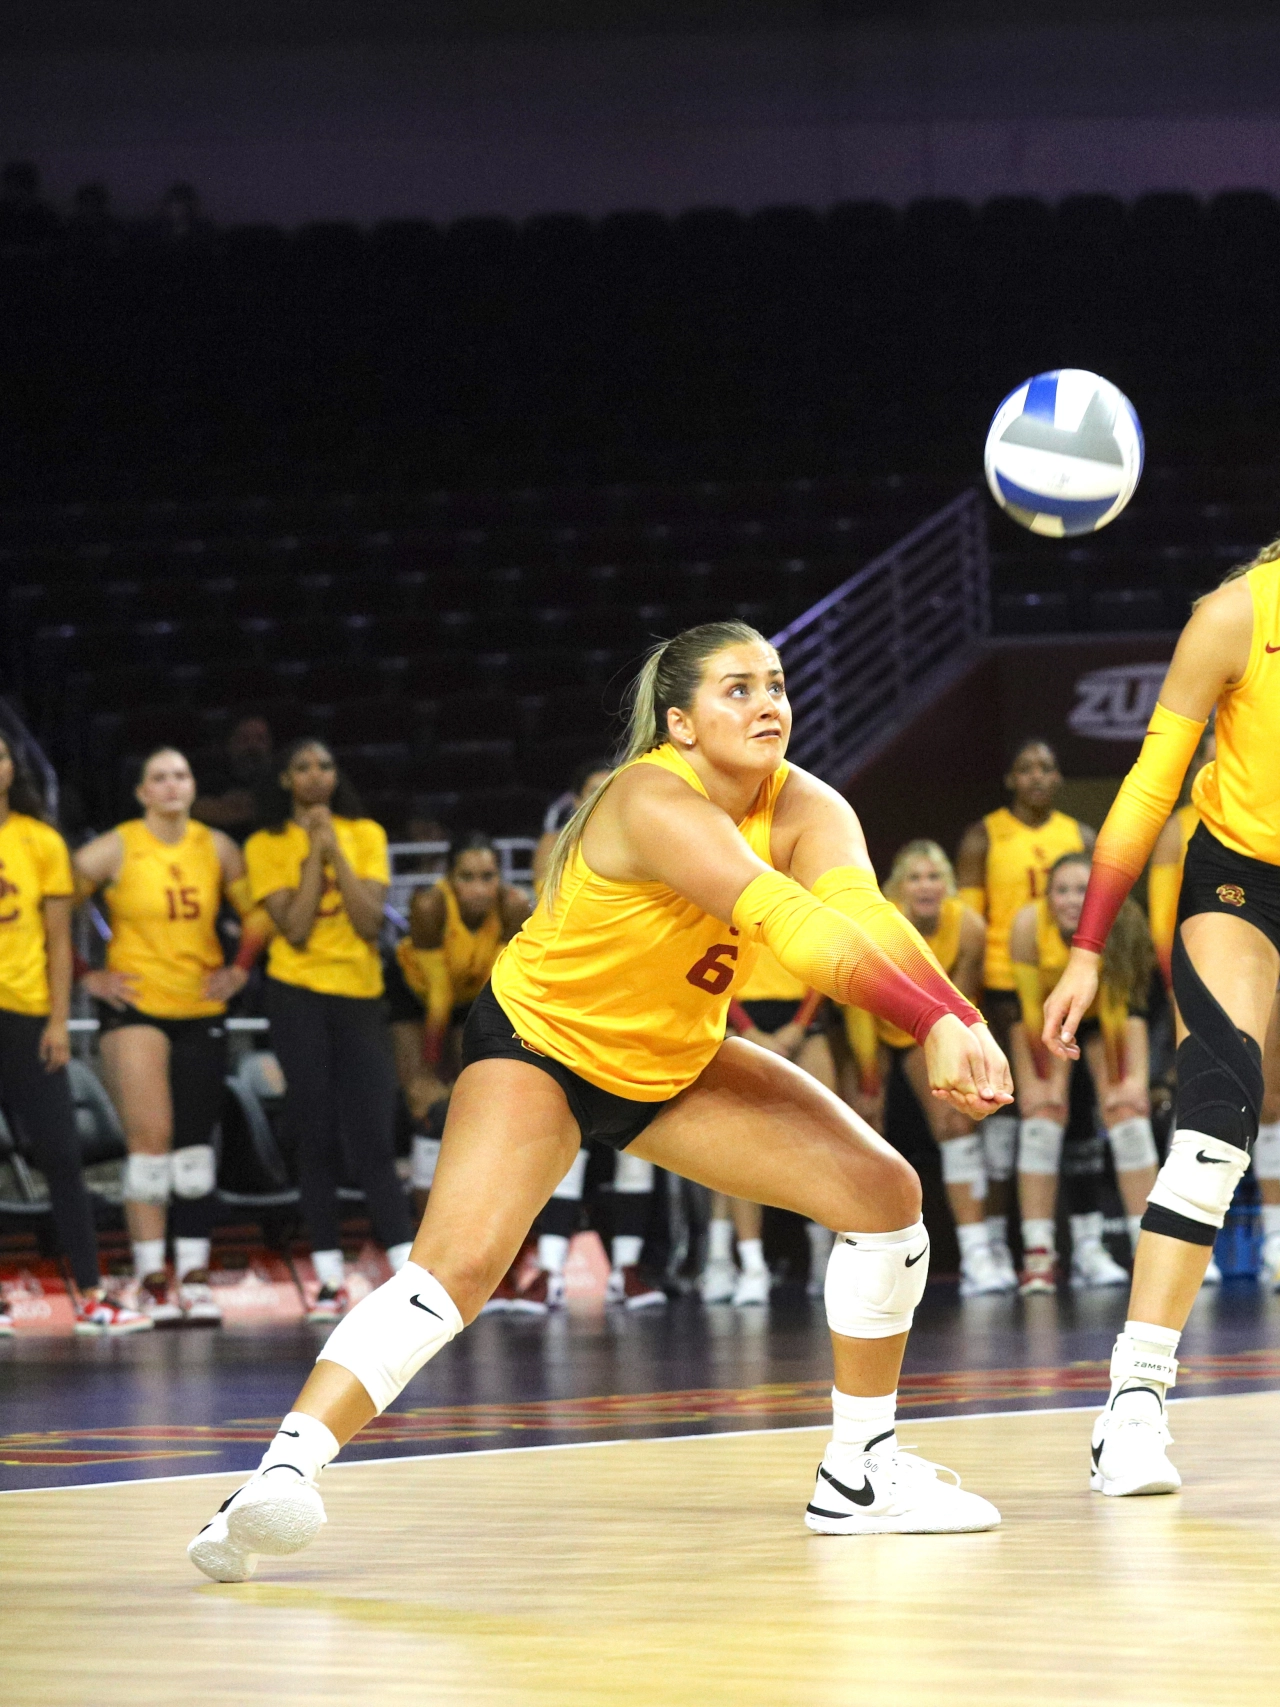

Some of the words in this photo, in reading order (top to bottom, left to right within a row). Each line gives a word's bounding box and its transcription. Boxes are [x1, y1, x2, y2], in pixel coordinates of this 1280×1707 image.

[1068, 681, 1153, 722] ZU
[166, 886, 201, 920] 15
[685, 943, 738, 995] 6
